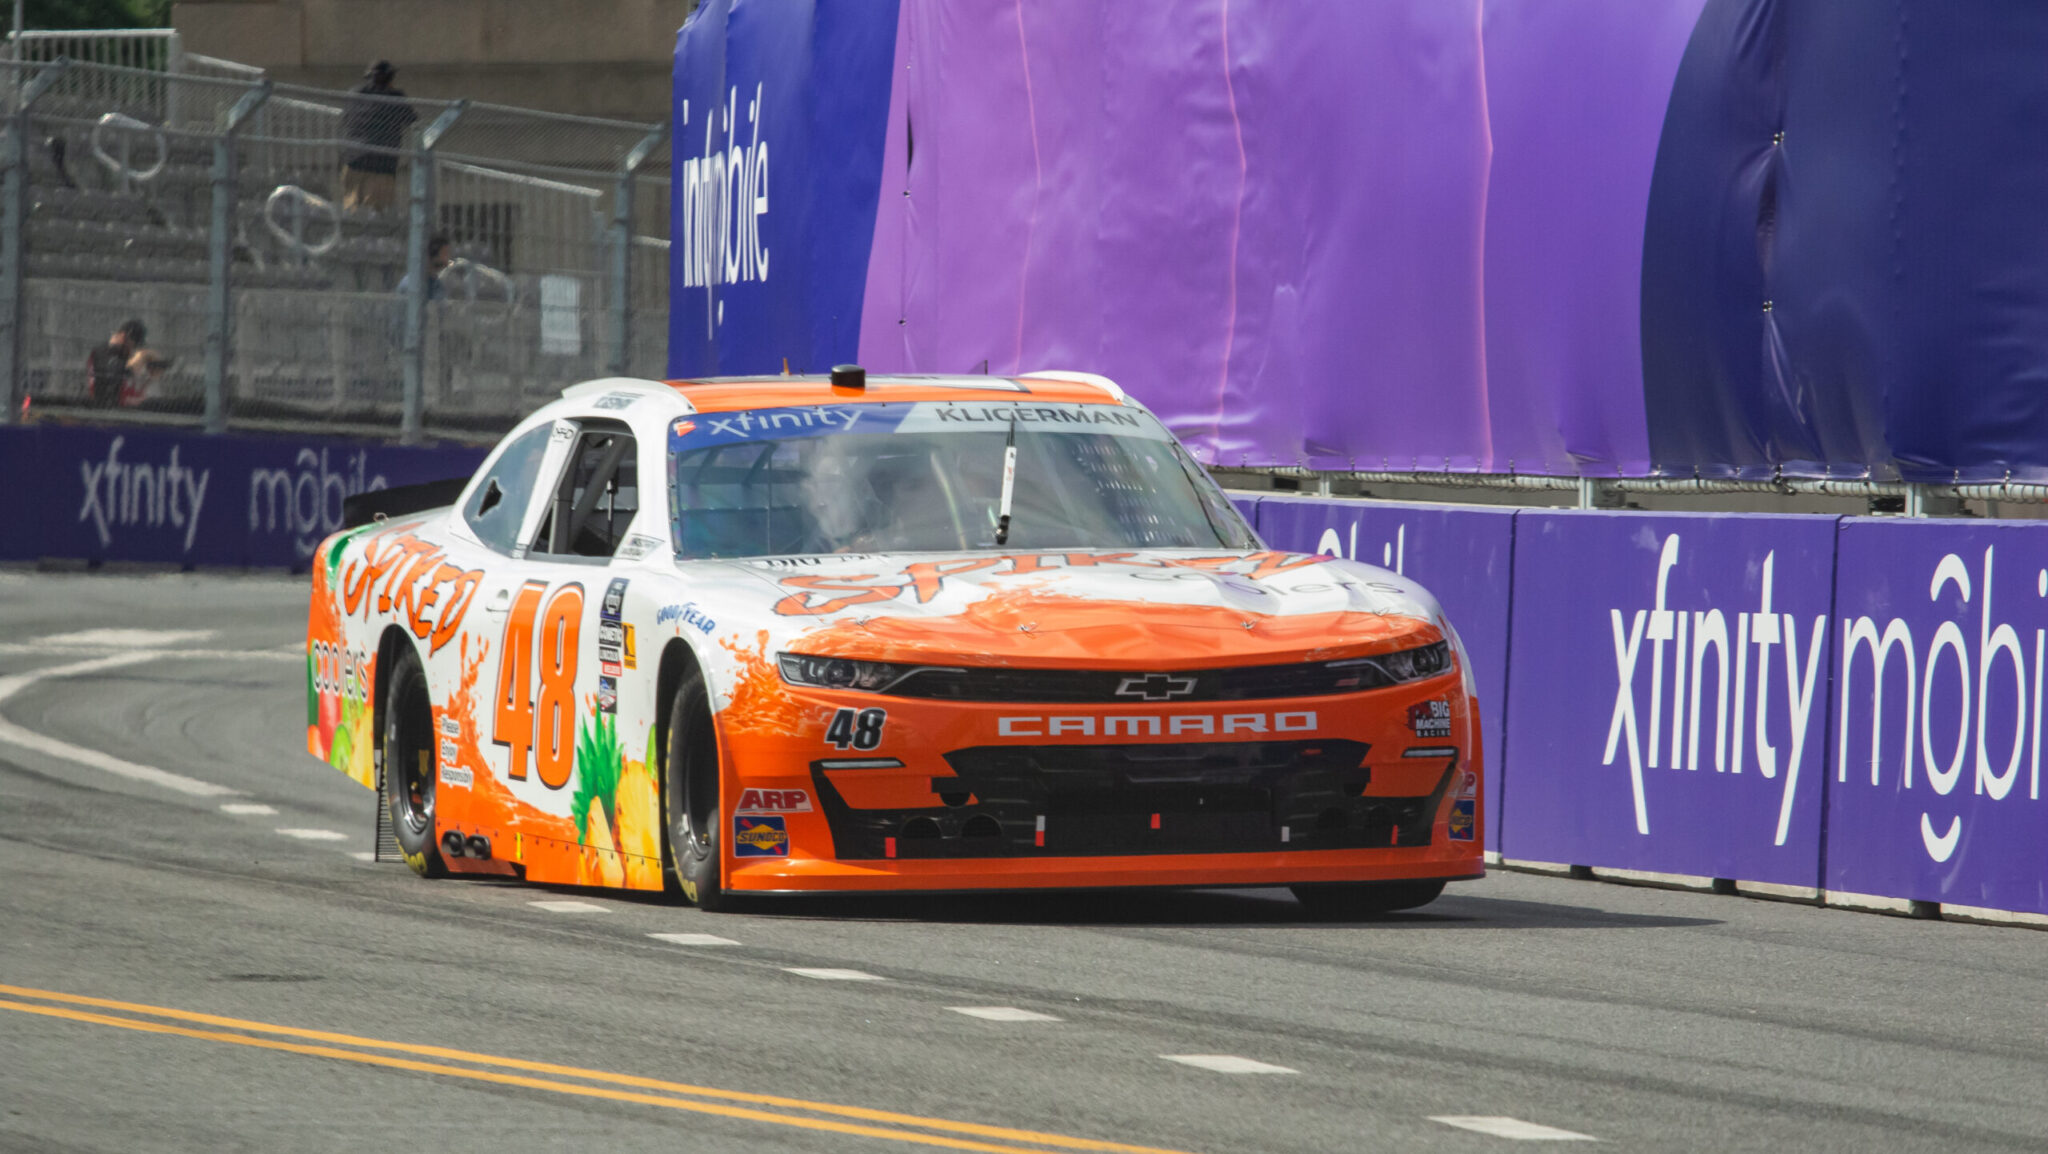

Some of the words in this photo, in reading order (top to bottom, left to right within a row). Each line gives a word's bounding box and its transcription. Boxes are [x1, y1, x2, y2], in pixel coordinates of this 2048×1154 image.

[708, 406, 863, 438] xfinity
[935, 407, 1141, 428] KLIGERMAN
[80, 435, 209, 551] xfinity
[492, 578, 585, 791] 48
[1603, 533, 1826, 847] xfinity
[1431, 701, 1450, 718] BIG
[825, 708, 887, 750] 48
[998, 711, 1318, 737] CAMARO
[1415, 718, 1450, 730] MACHINE
[1416, 730, 1451, 738] RACING
[738, 789, 808, 811] ARP
[737, 830, 787, 844] SUNOCO
